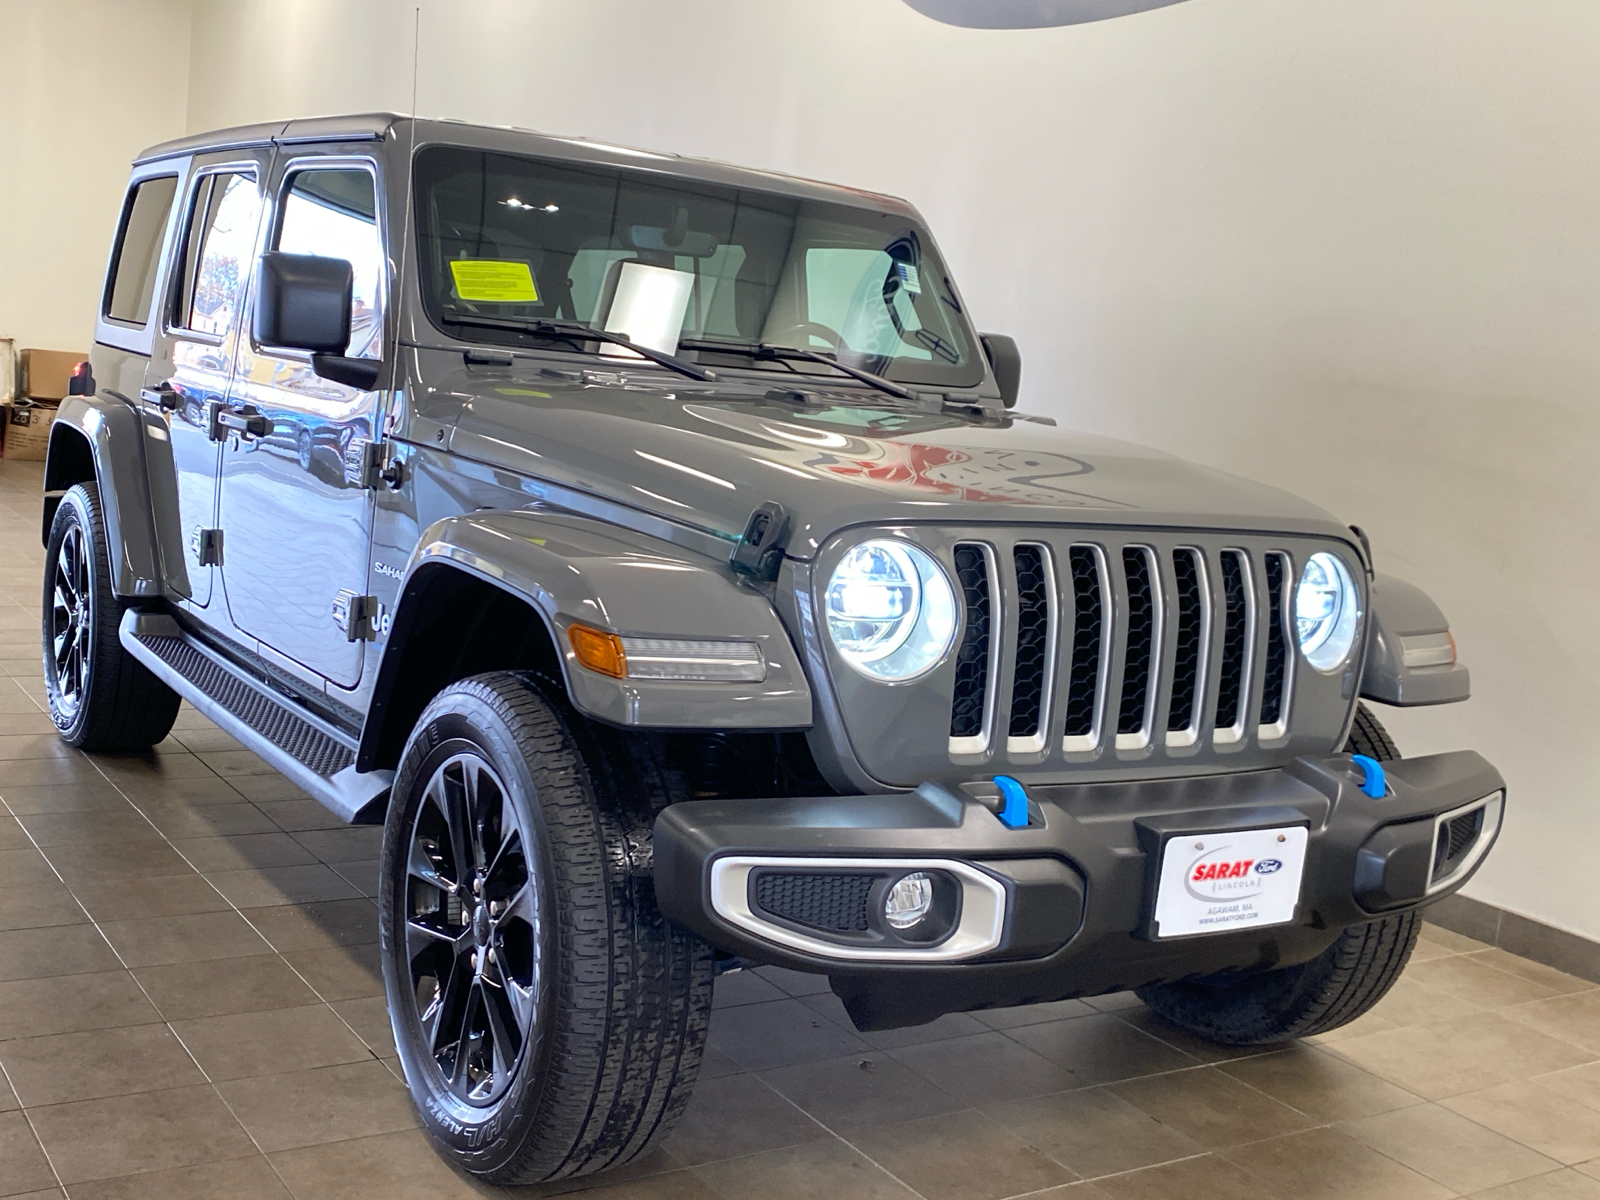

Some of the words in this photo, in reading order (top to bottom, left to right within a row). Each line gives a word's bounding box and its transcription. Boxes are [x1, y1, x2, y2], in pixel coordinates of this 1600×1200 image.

[1192, 859, 1254, 881] SARAT
[1257, 859, 1280, 873] Ford
[1218, 880, 1255, 890] LINCOLN
[1207, 905, 1240, 916] AGAWAM,
[1242, 903, 1253, 911] MA
[1199, 912, 1258, 924] WWW.SARATFORD.COM
[425, 1096, 463, 1135] ALENZA
